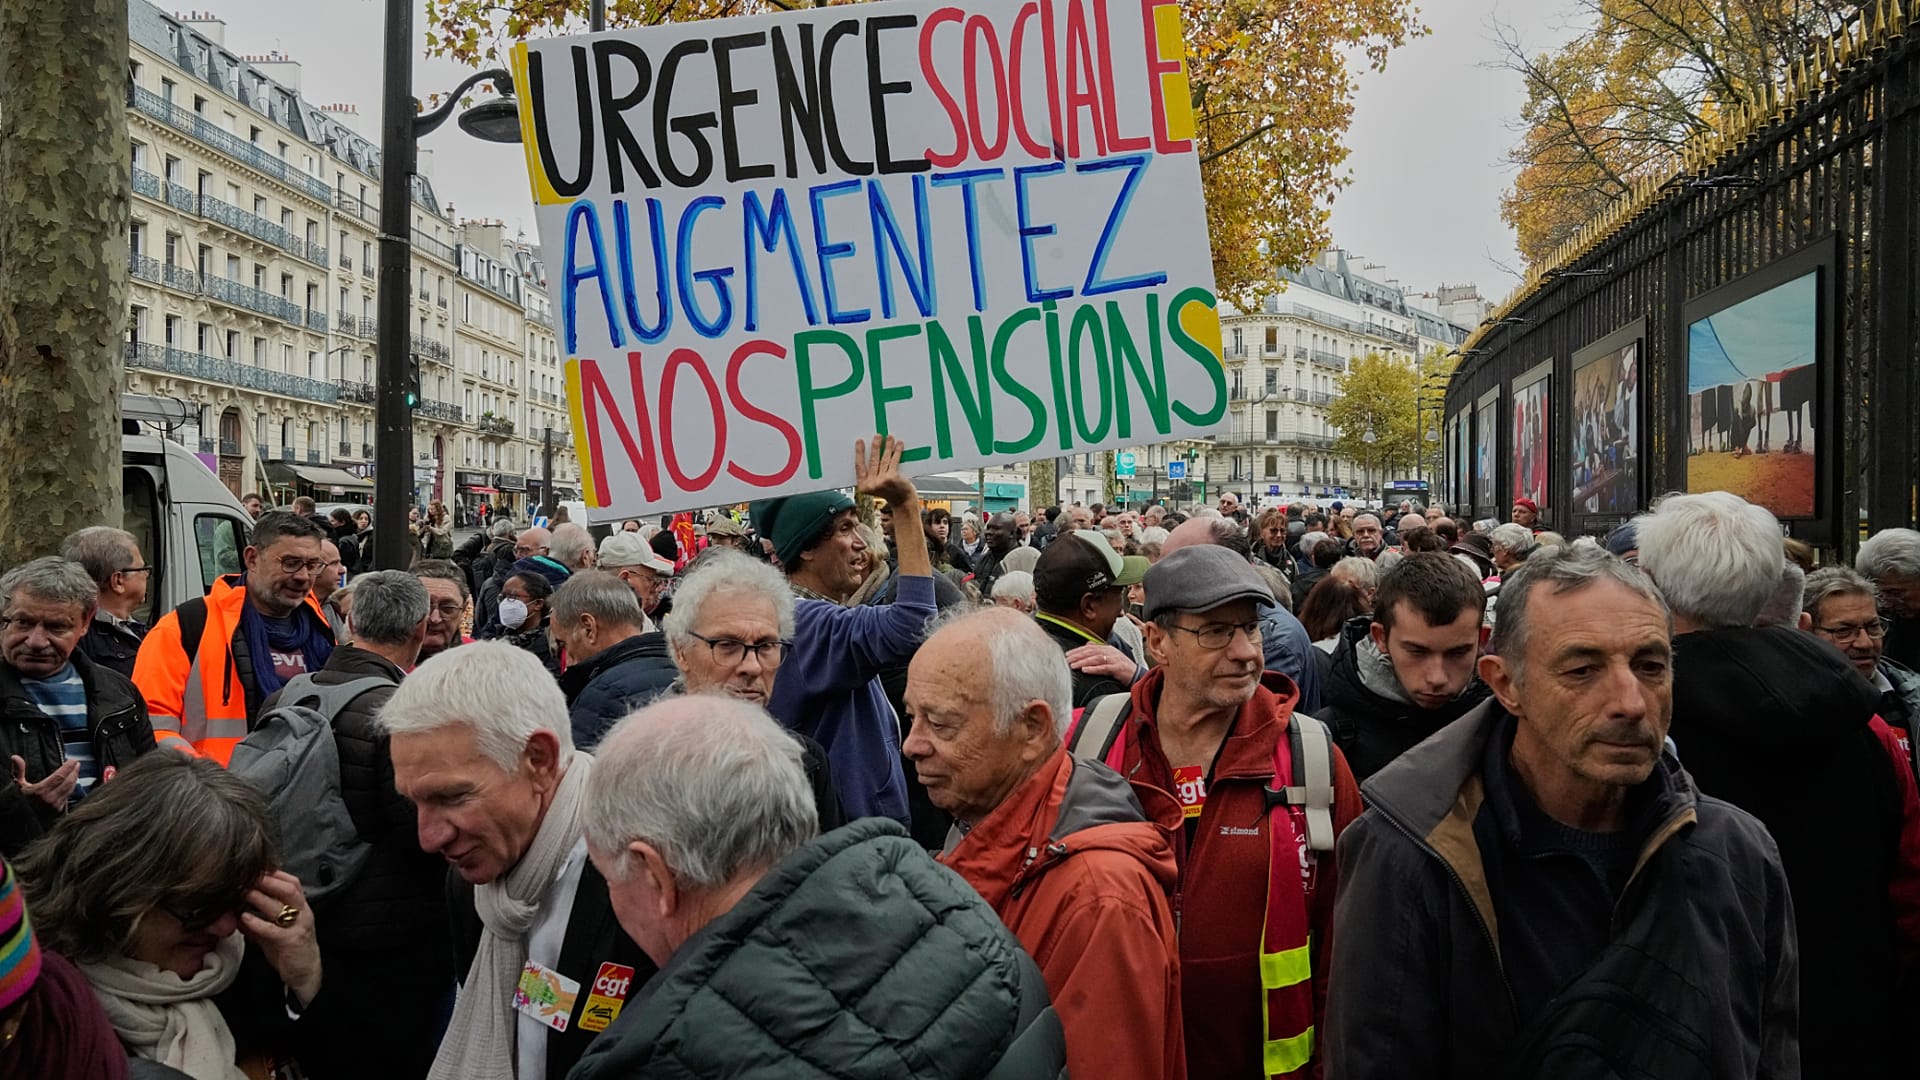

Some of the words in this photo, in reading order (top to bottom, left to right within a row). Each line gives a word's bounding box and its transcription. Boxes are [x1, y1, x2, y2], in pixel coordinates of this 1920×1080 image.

[528, 15, 932, 197] URGENCE
[918, 0, 1193, 169] SOCIALE
[560, 152, 1168, 356] AUGMENTEZ
[580, 339, 803, 508] NOS
[596, 976, 629, 997] cgt
